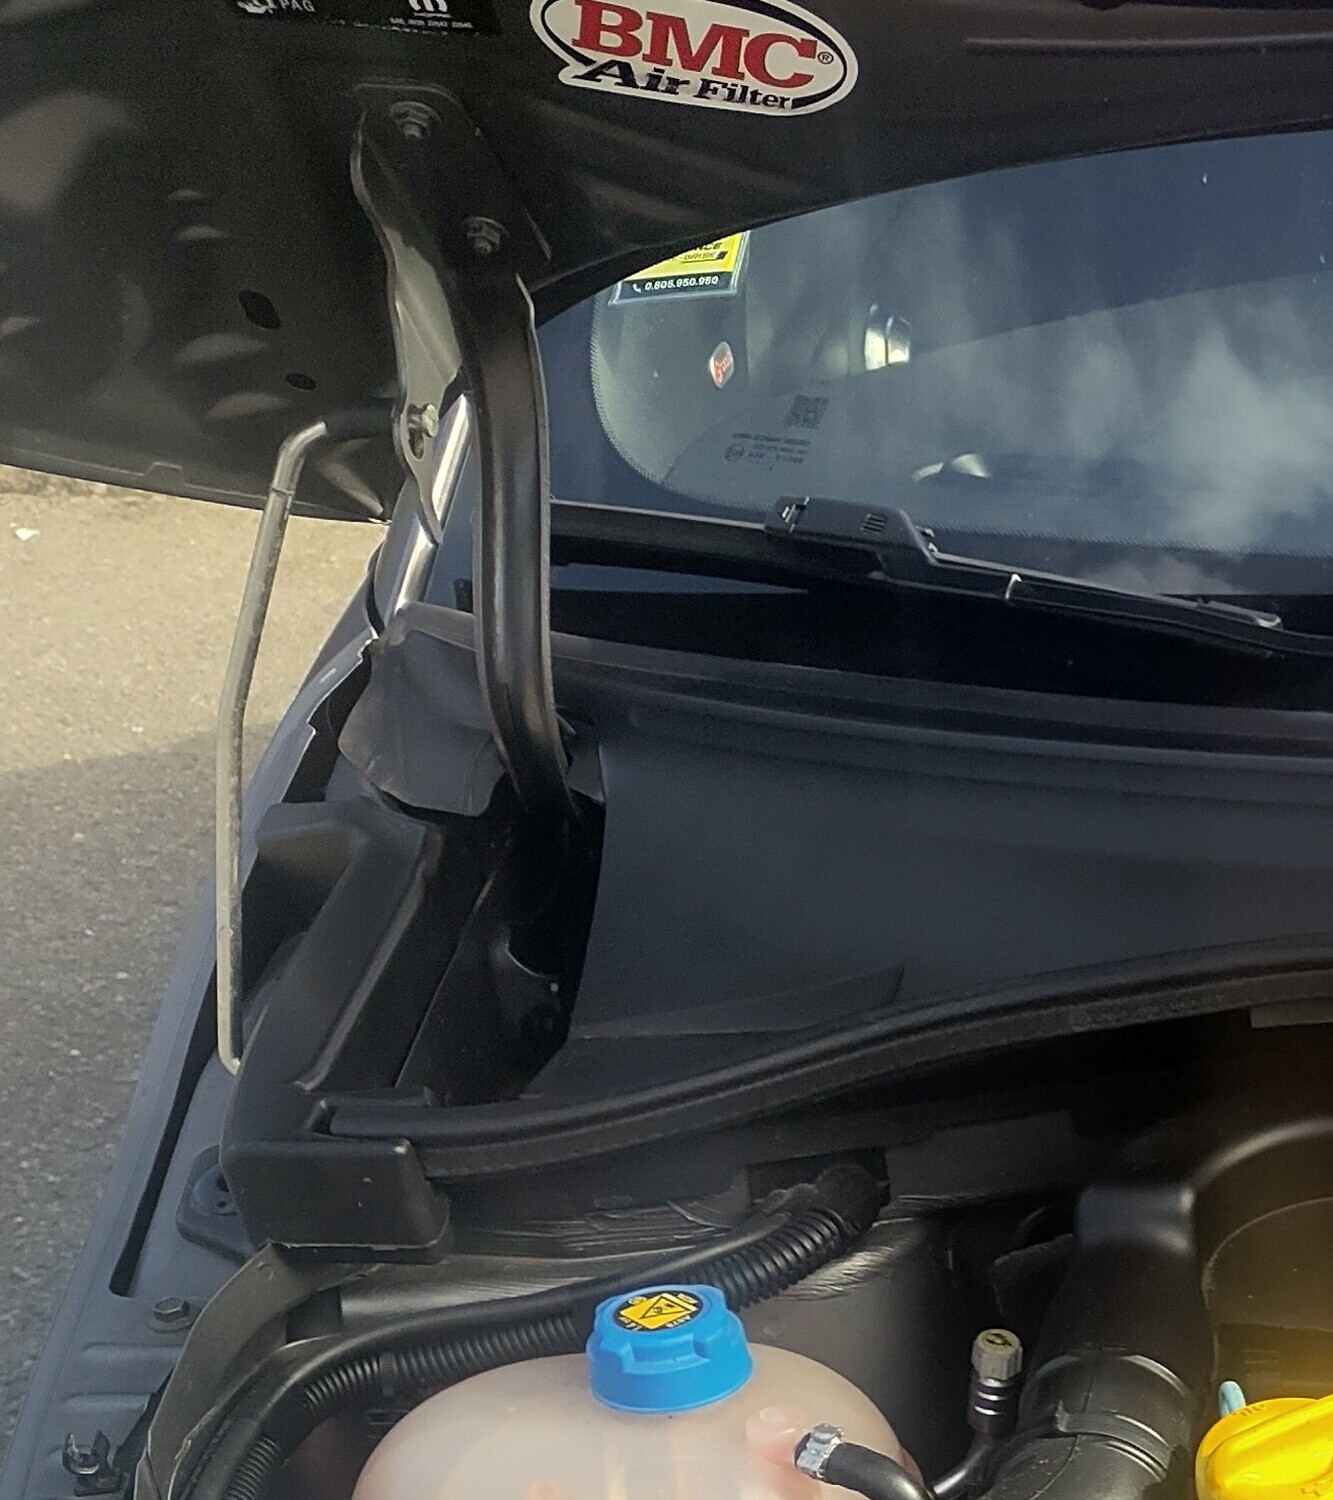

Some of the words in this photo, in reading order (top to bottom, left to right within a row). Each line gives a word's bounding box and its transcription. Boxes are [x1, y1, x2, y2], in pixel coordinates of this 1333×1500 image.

[571, 0, 818, 89] BMC
[573, 59, 690, 96] Air
[693, 78, 791, 109] Filter
